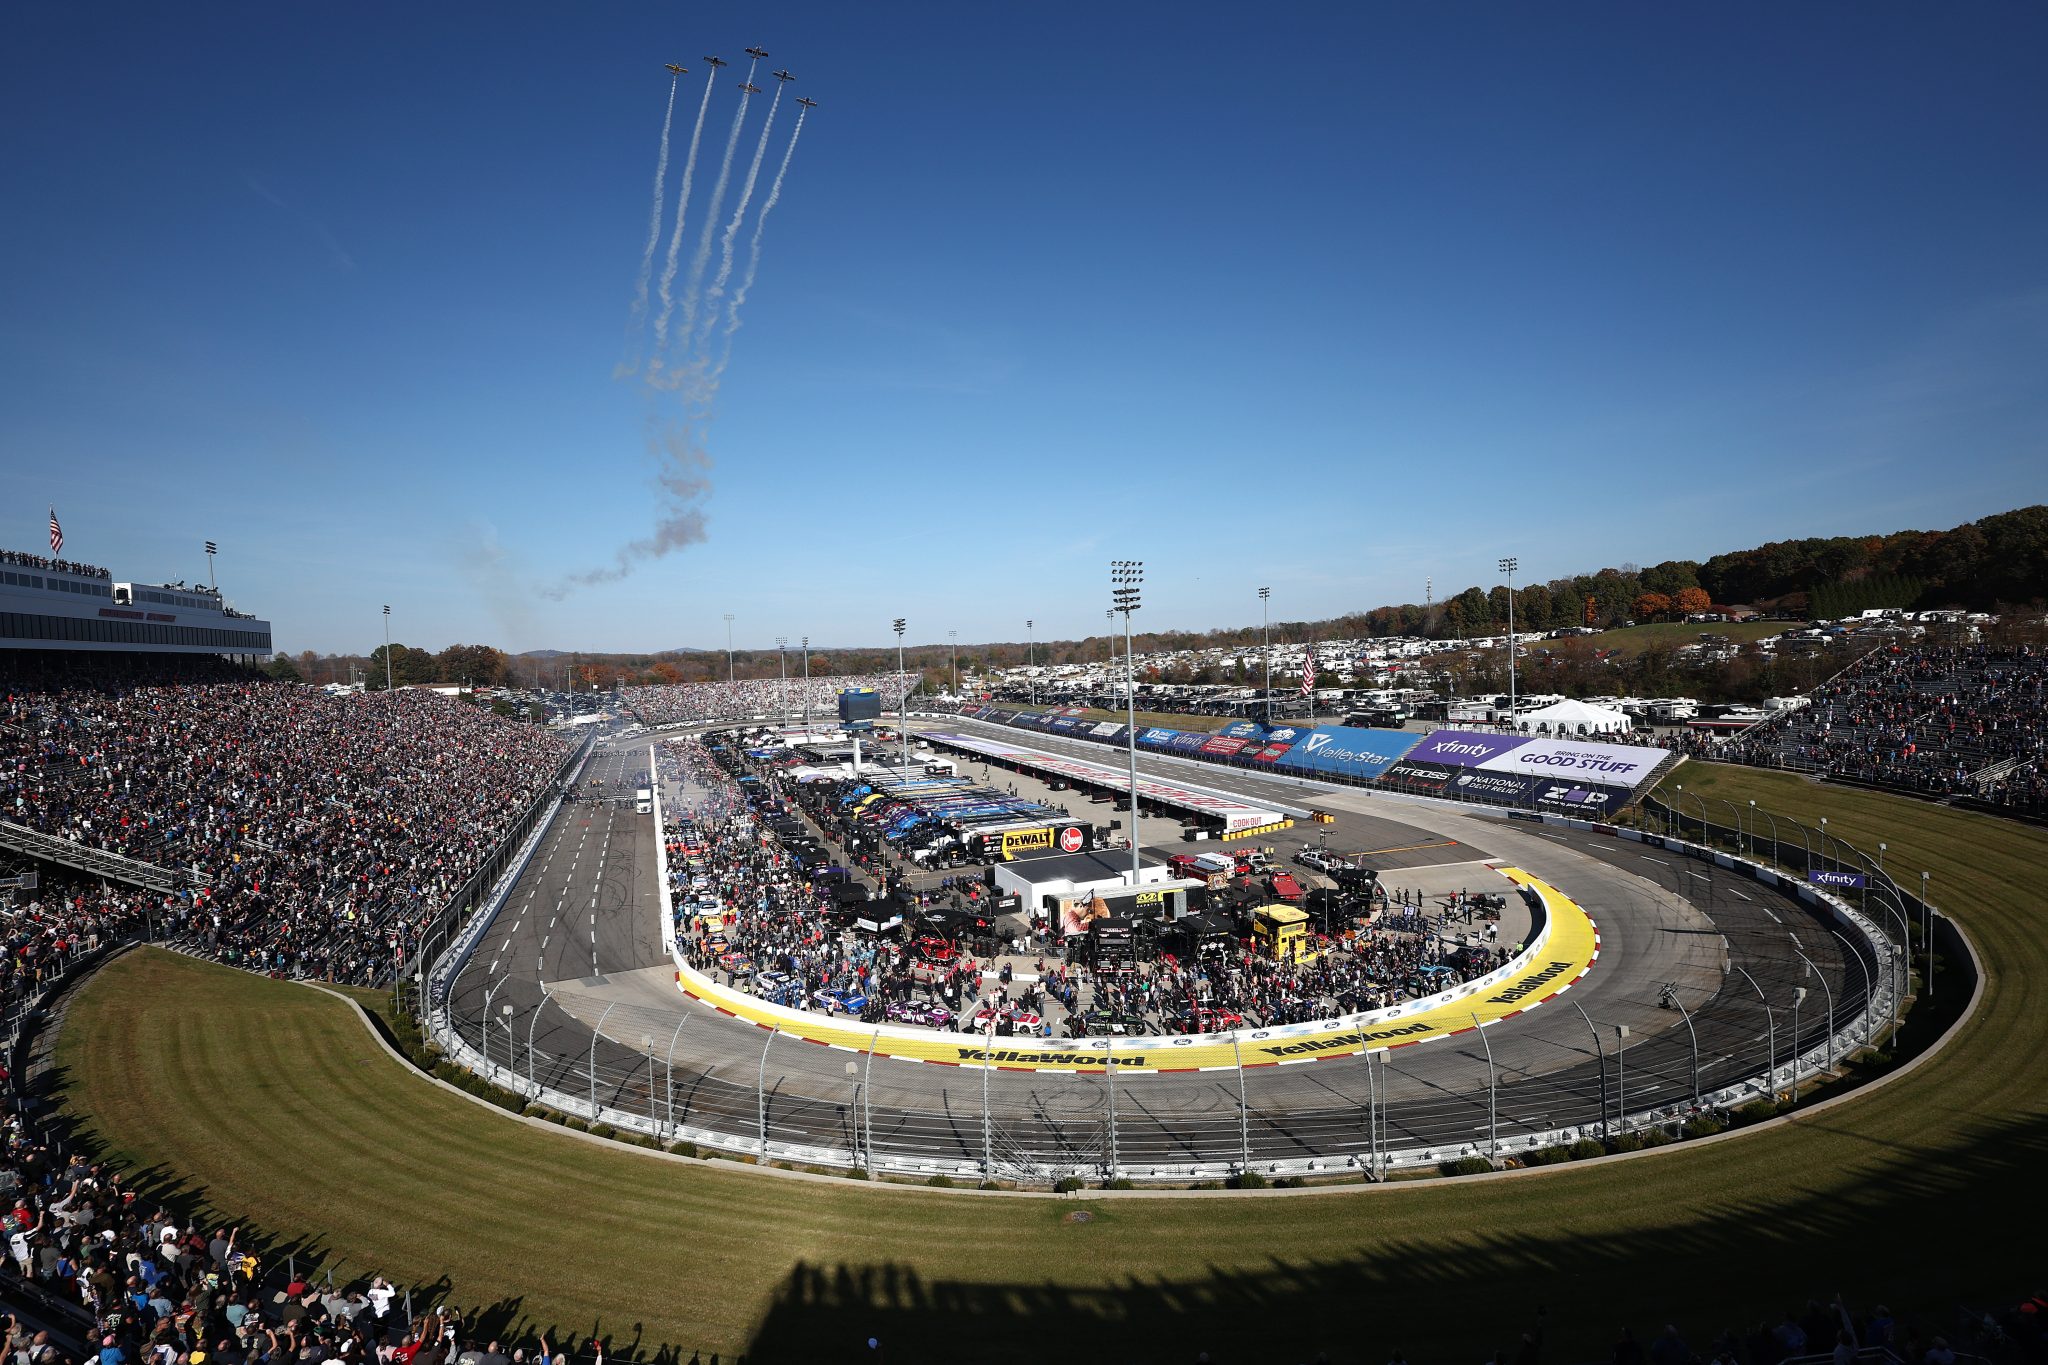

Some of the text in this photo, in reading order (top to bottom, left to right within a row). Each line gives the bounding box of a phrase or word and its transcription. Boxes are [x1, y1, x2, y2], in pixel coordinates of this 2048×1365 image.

[1172, 733, 1206, 749] xfinity
[1430, 740, 1495, 758] xfinity
[1317, 746, 1391, 765] ValleyStar
[1520, 753, 1639, 774] GOOD STUFF
[1554, 750, 1580, 759] BRING
[1581, 752, 1597, 760] ON
[1472, 776, 1527, 790] NATIONAL
[1544, 785, 1609, 804] zip
[1816, 873, 1857, 886] xfinity
[1486, 961, 1574, 1004] YellaWood
[916, 1014, 926, 1023] 48
[1260, 1023, 1435, 1057] YellaWood
[957, 1048, 1146, 1067] YellaWood
